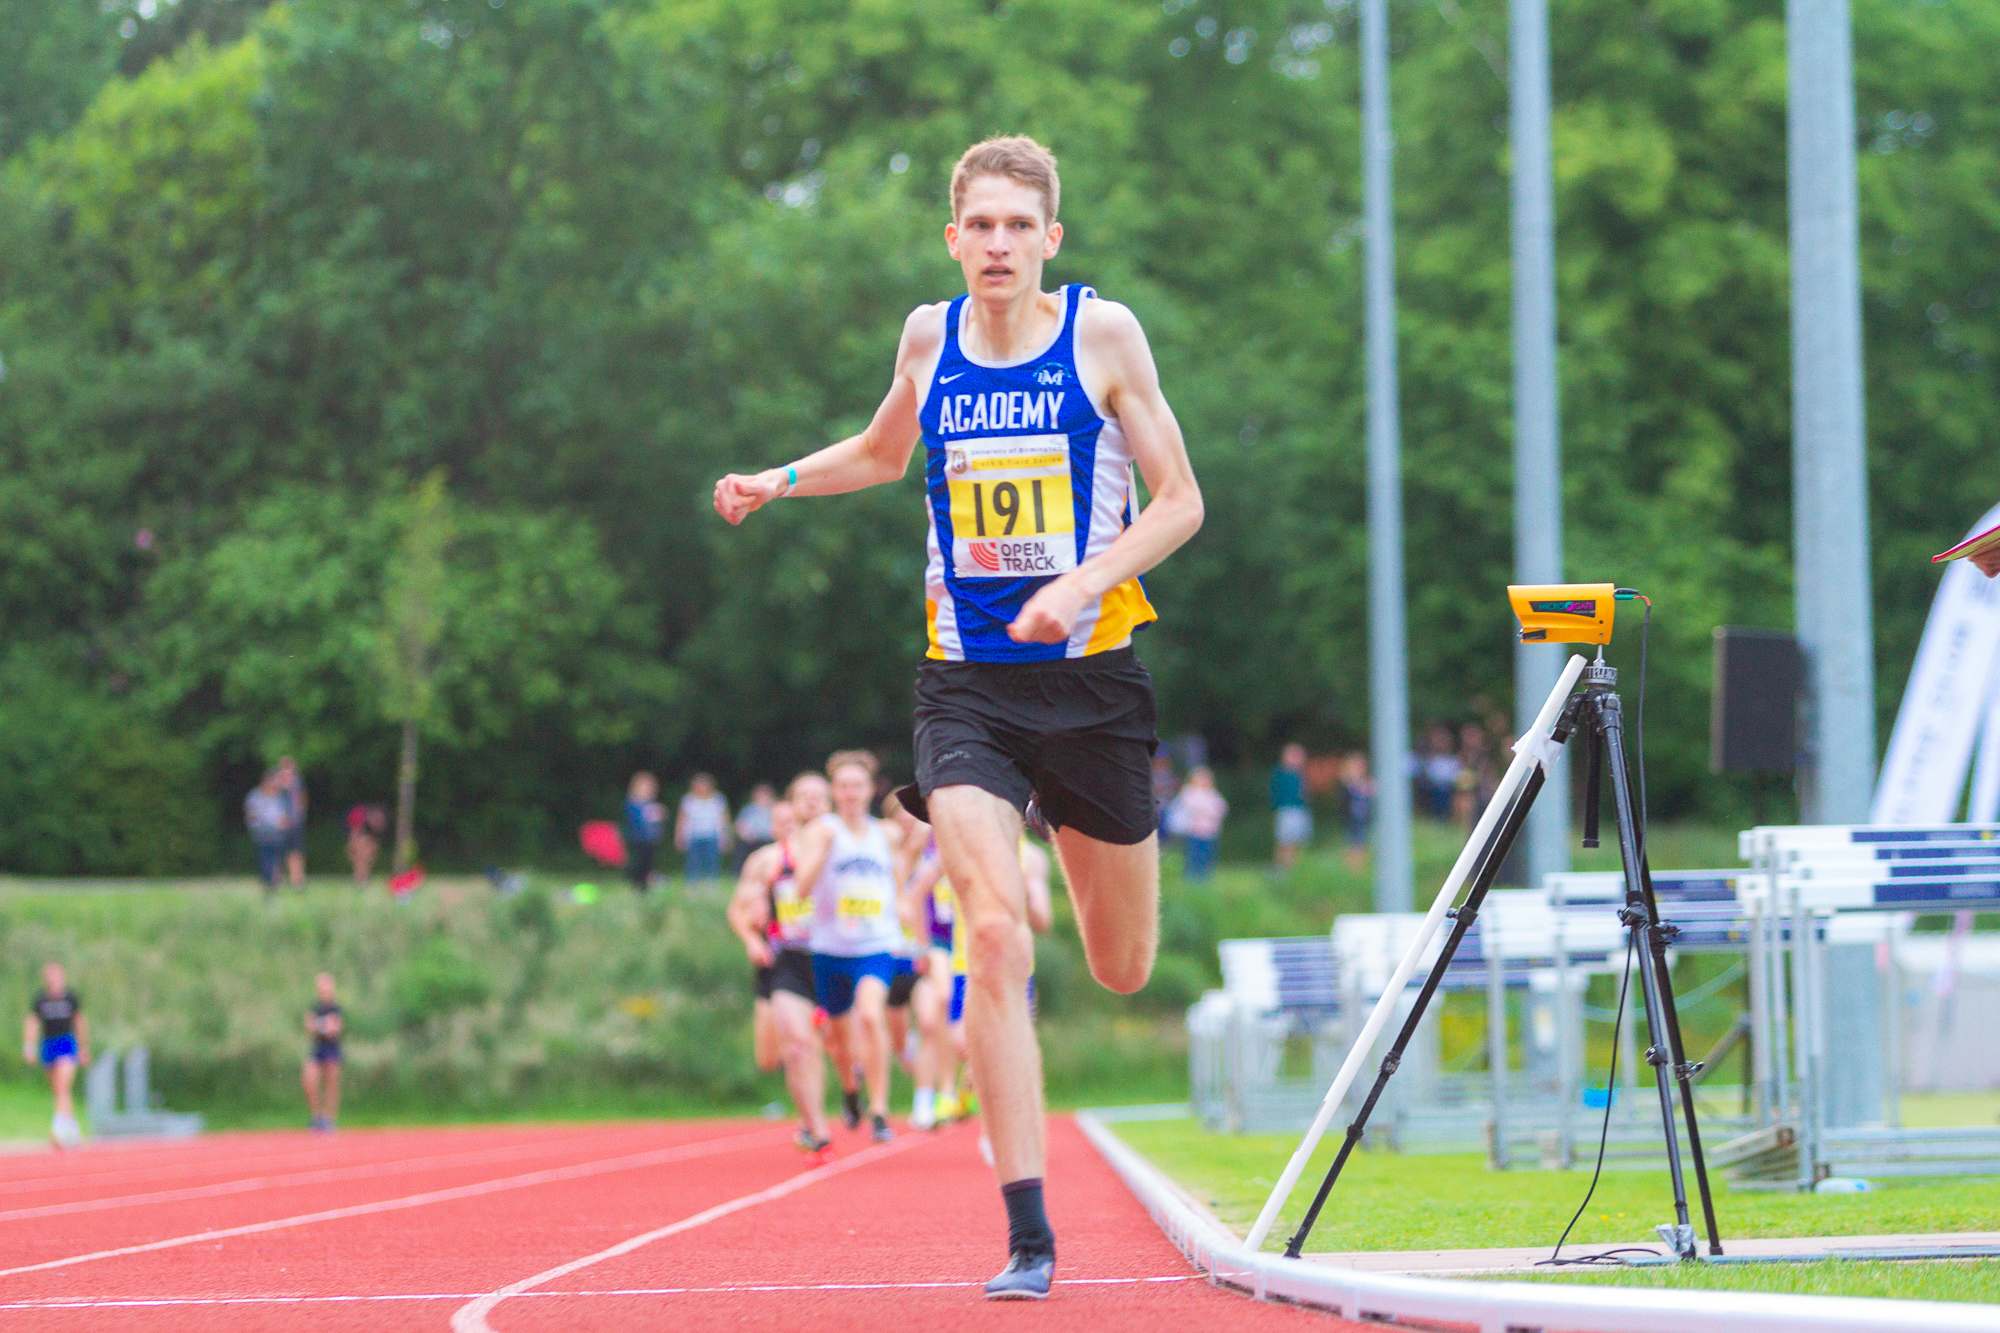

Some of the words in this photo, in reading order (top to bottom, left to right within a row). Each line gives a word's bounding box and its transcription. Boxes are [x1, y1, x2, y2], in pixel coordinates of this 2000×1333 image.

[938, 391, 1064, 434] ACADEMY
[971, 448, 1006, 456] University
[1019, 446, 1063, 455] Birmingham
[972, 459, 994, 467] Track
[1007, 458, 1029, 466] Field
[1033, 456, 1062, 464] Series
[973, 479, 1045, 537] 191
[1001, 542, 1045, 556] OPEN
[1003, 555, 1055, 571] TRACK
